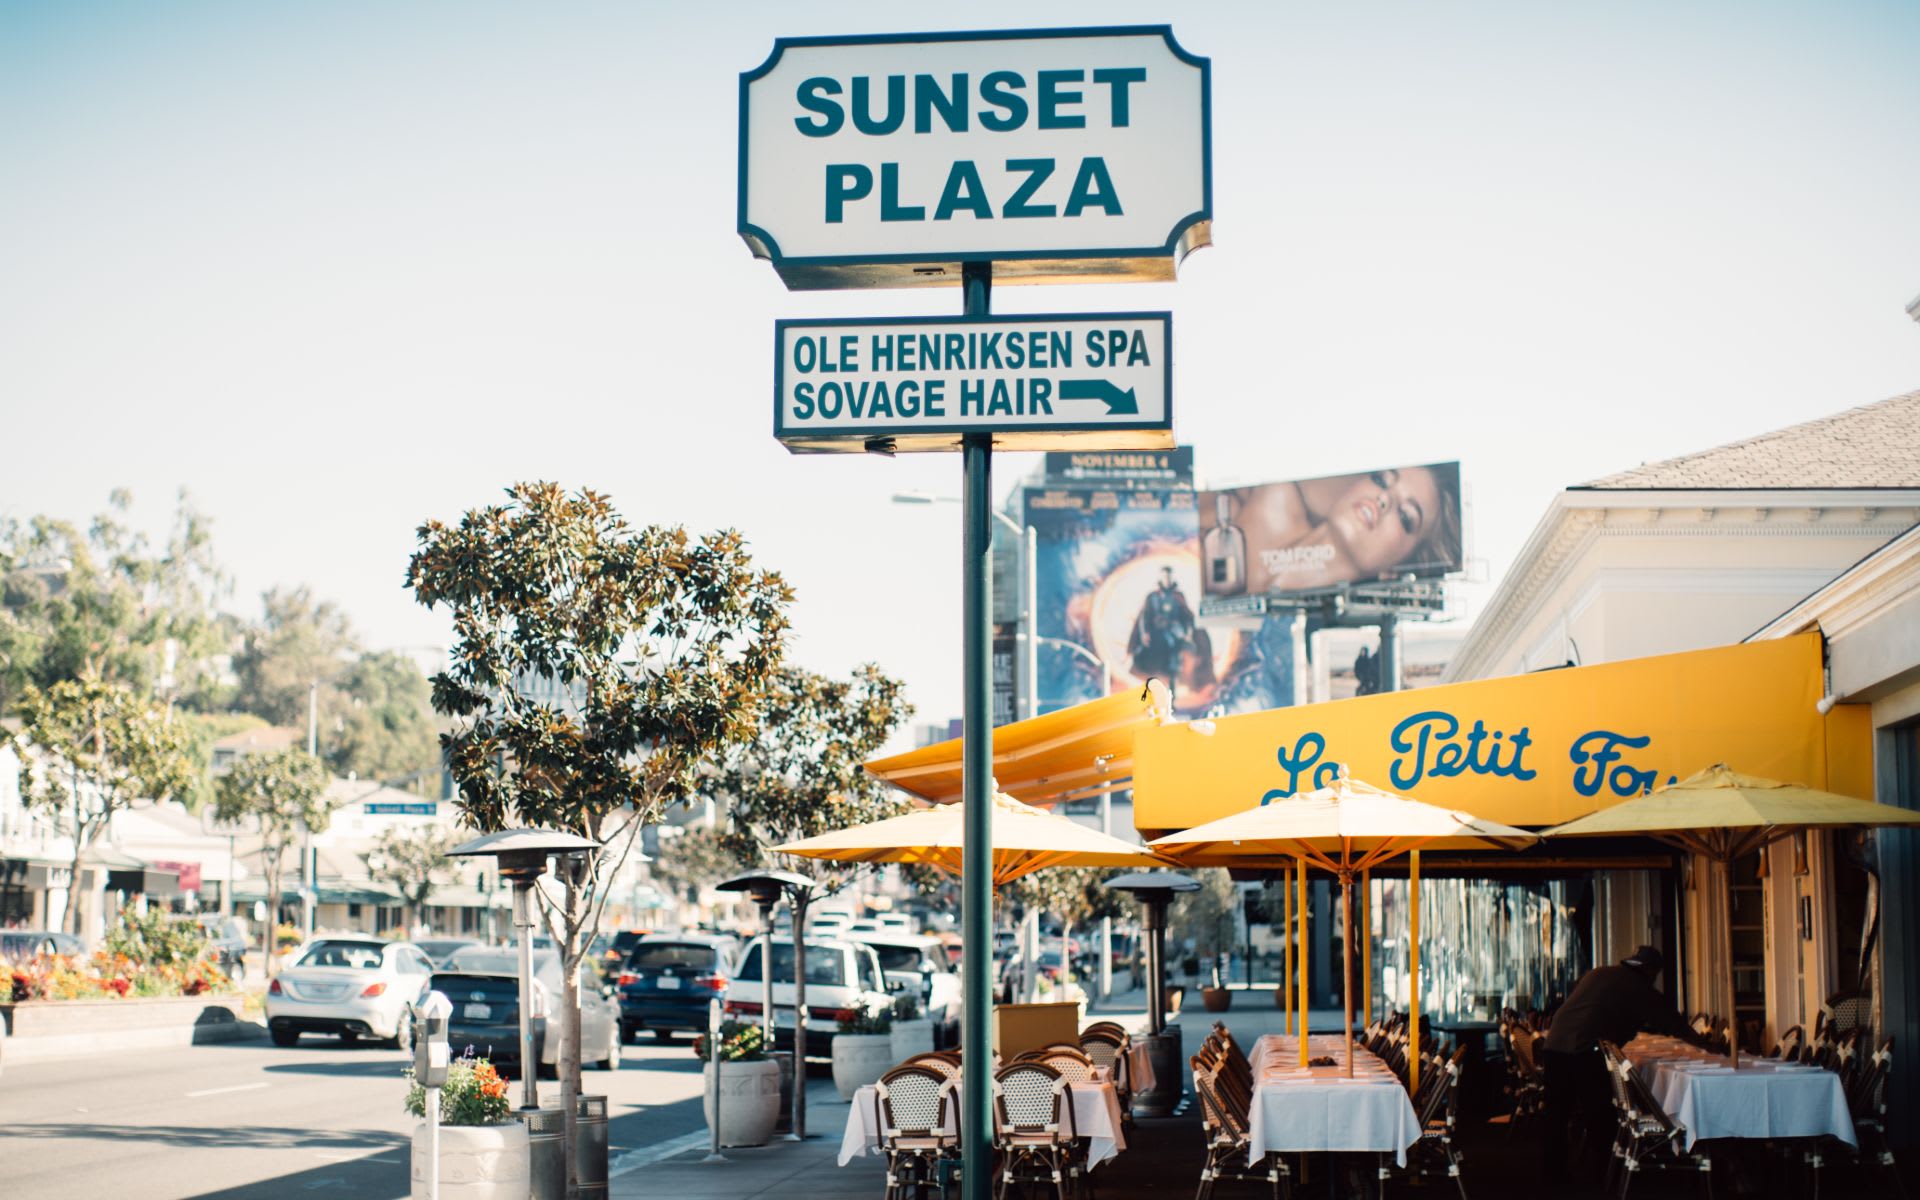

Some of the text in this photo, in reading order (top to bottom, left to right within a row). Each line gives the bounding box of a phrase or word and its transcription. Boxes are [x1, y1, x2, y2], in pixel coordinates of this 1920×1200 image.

[794, 67, 1147, 138] SUNSET
[825, 157, 1124, 224] PLAZA
[793, 329, 1151, 374] OLE HENRIKSEN SPA
[792, 378, 1054, 420] SOVAGE HAIR
[1389, 711, 1537, 790] Petit
